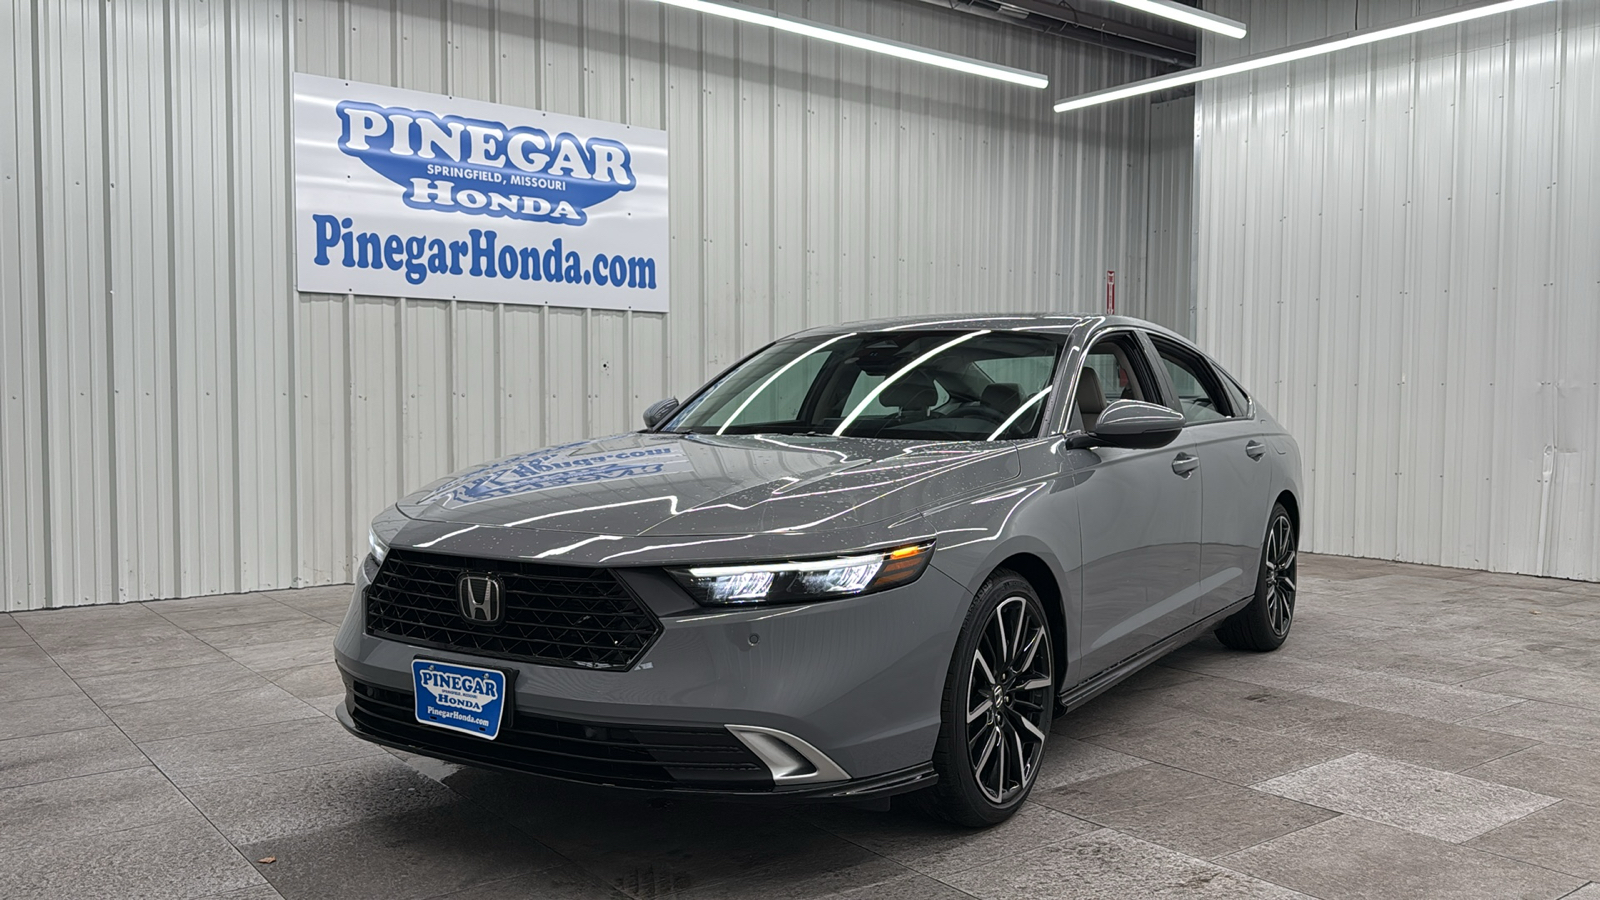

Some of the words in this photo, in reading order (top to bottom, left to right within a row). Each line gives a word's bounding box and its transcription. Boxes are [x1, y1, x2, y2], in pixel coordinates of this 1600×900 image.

[343, 107, 631, 186] PINEGAR
[426, 164, 507, 185] SPRINGFIELD,
[510, 174, 566, 191] MISSOURI
[409, 177, 582, 220] HONDA
[313, 214, 657, 290] PinegarHonda.com
[421, 671, 496, 698] PINEGAR
[437, 693, 481, 710] HONDA
[427, 705, 490, 727] PinegarHonda.com
